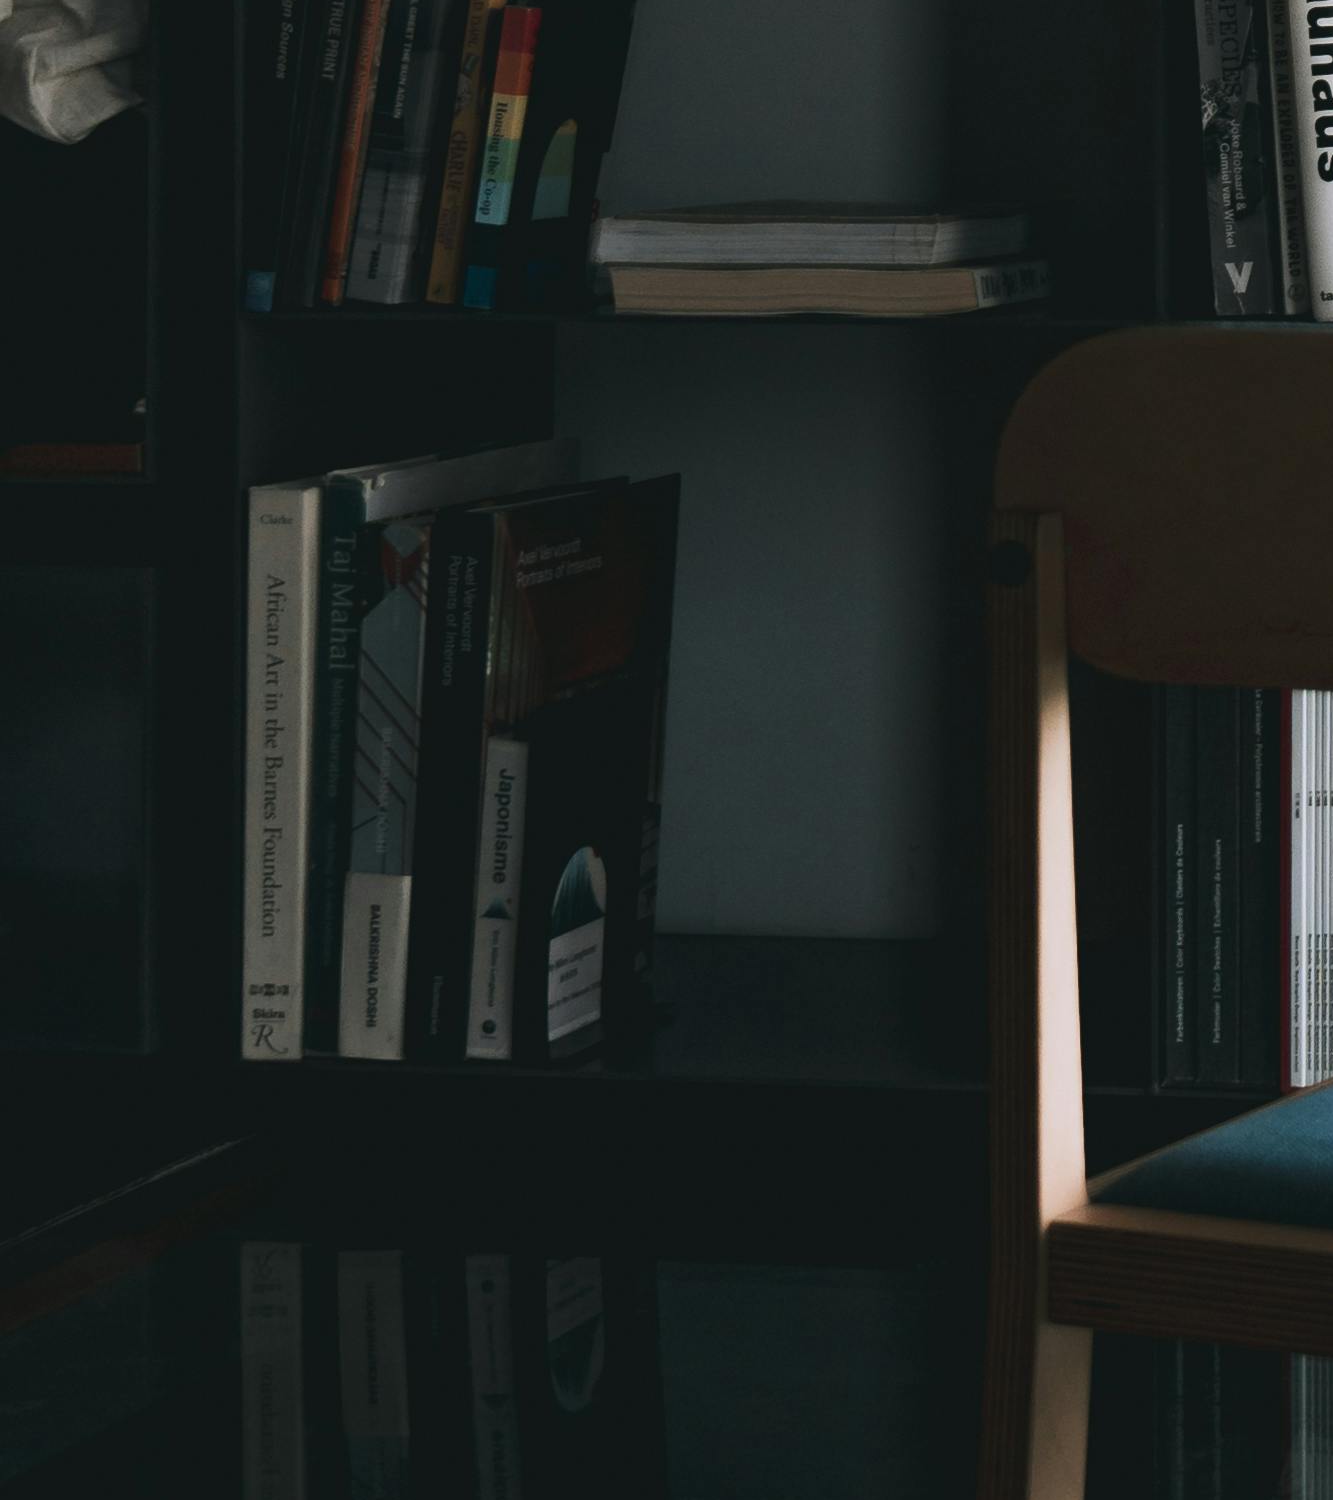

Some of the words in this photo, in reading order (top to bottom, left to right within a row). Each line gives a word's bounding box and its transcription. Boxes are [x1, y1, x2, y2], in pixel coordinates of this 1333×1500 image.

[262, 575, 285, 646] African
[264, 654, 284, 685] Art
[265, 692, 282, 708] in
[264, 715, 284, 750] the
[262, 756, 282, 819] Barnes
[261, 826, 282, 938] Foundation
